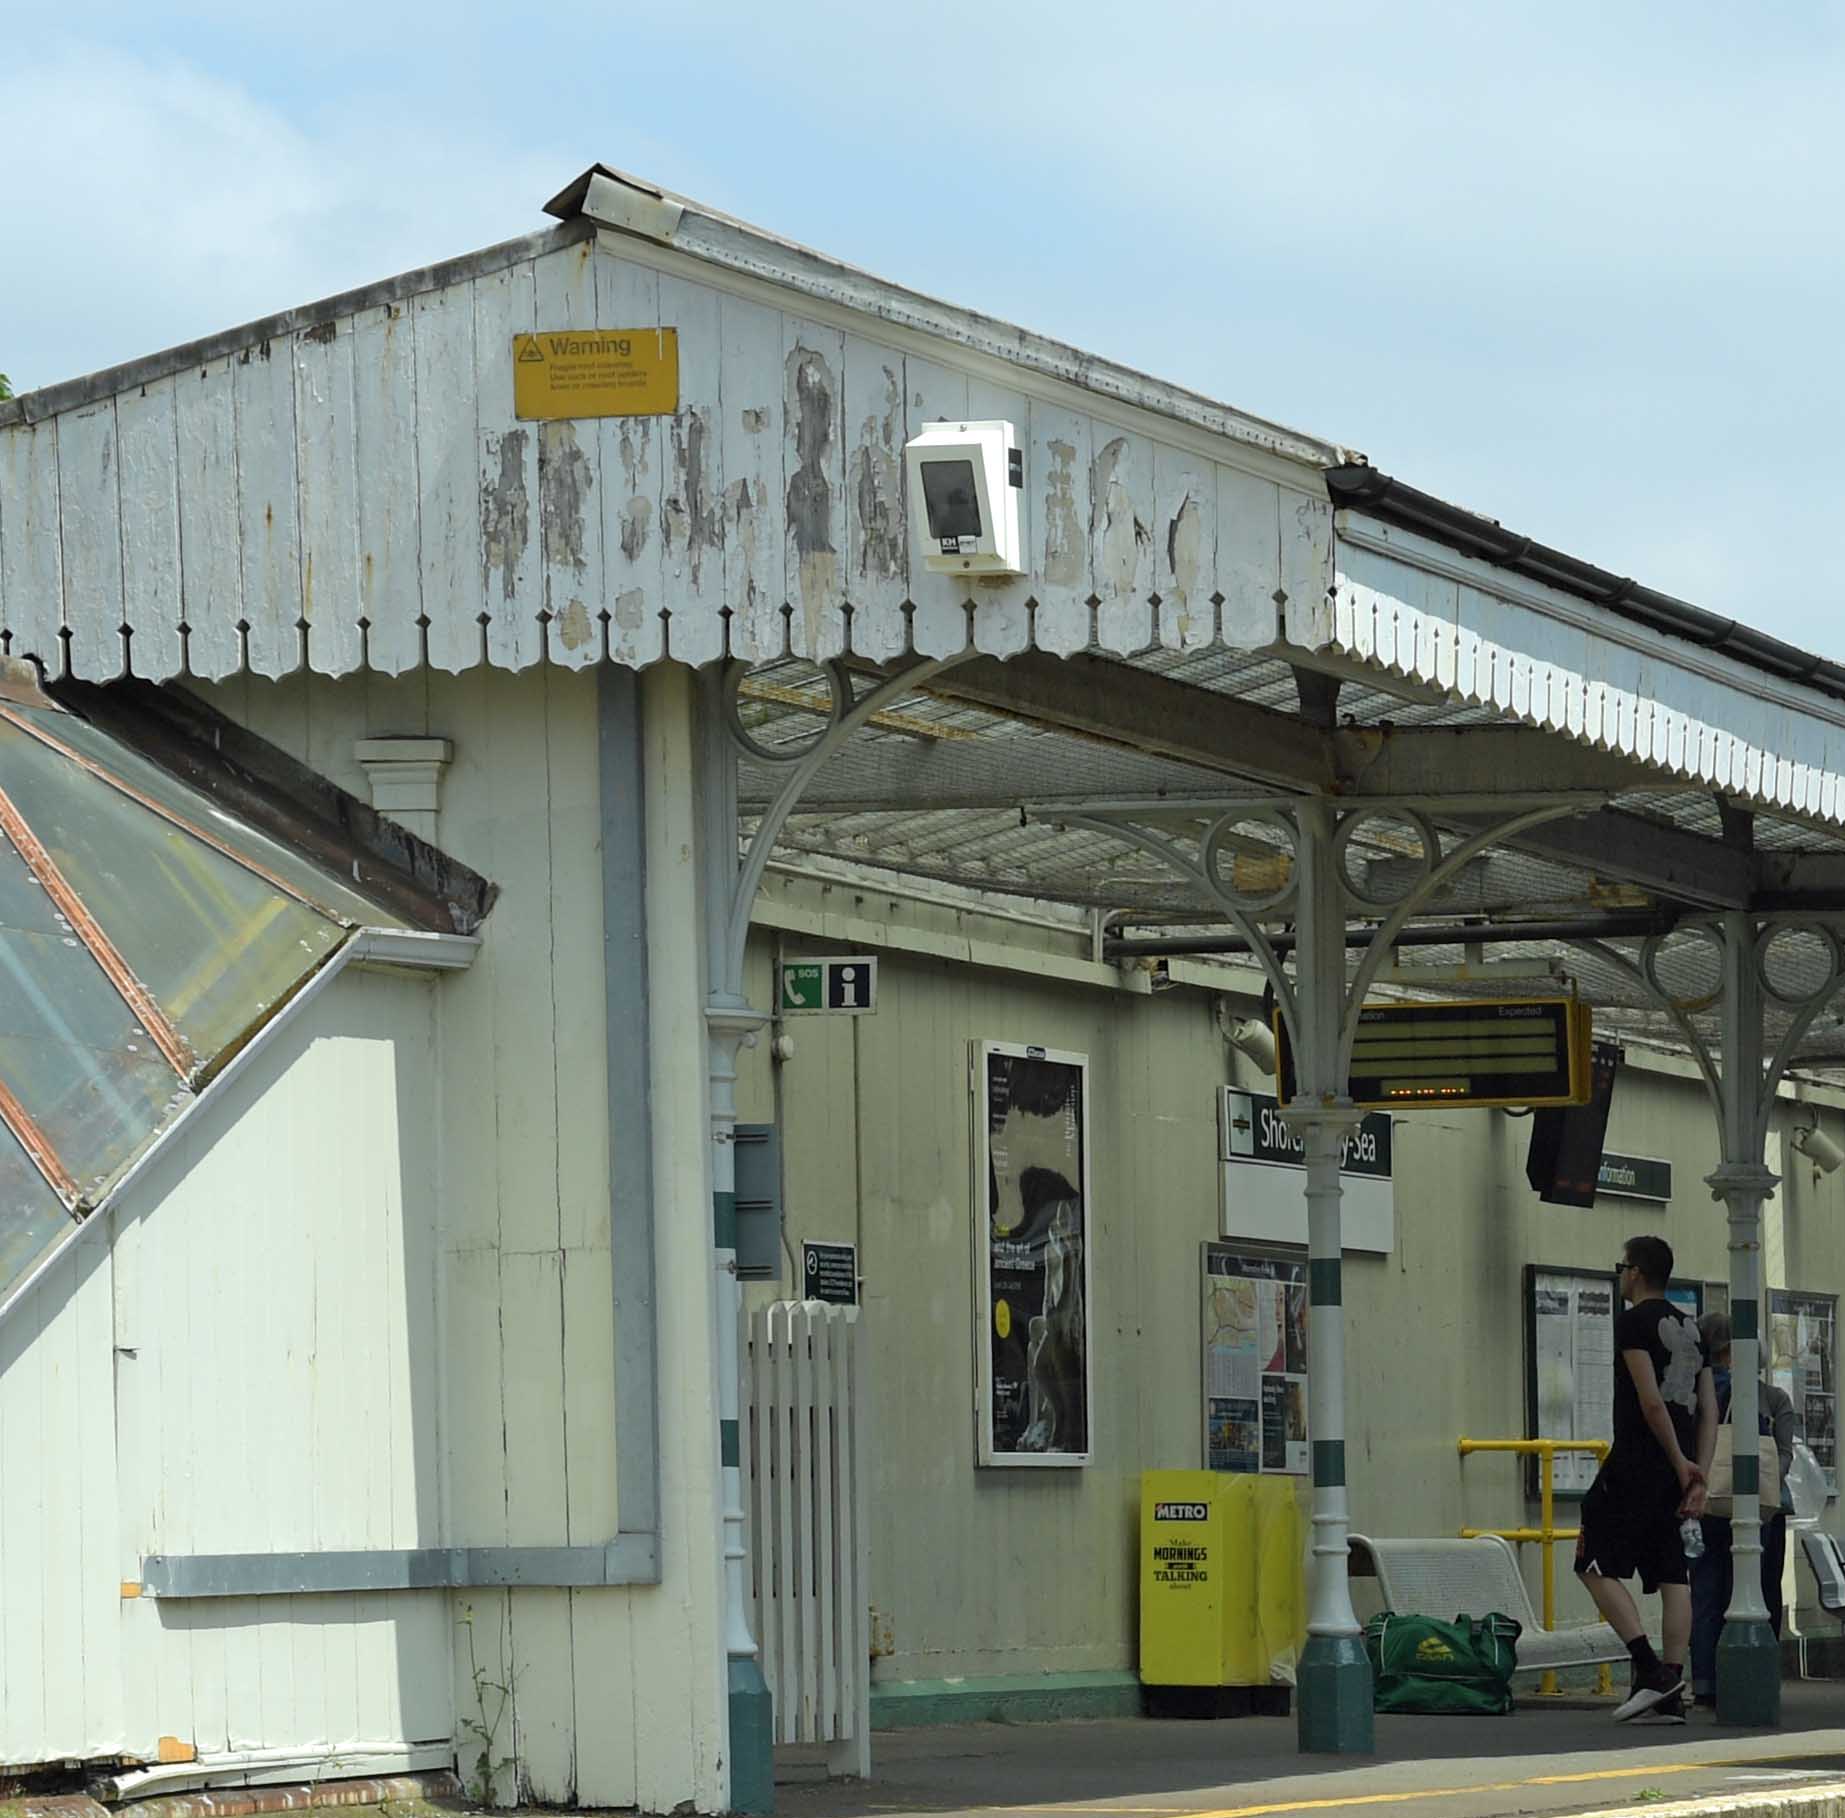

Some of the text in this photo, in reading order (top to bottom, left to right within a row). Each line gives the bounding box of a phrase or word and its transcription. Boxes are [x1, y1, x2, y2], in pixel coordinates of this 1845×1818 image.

[550, 337, 631, 356] Warning
[798, 968, 819, 978] SOS
[1498, 1006, 1543, 1018] Expected
[1155, 1504, 1206, 1519] METRO
[1153, 1547, 1208, 1561] MORNINGS
[1153, 1570, 1208, 1582] TALKING
